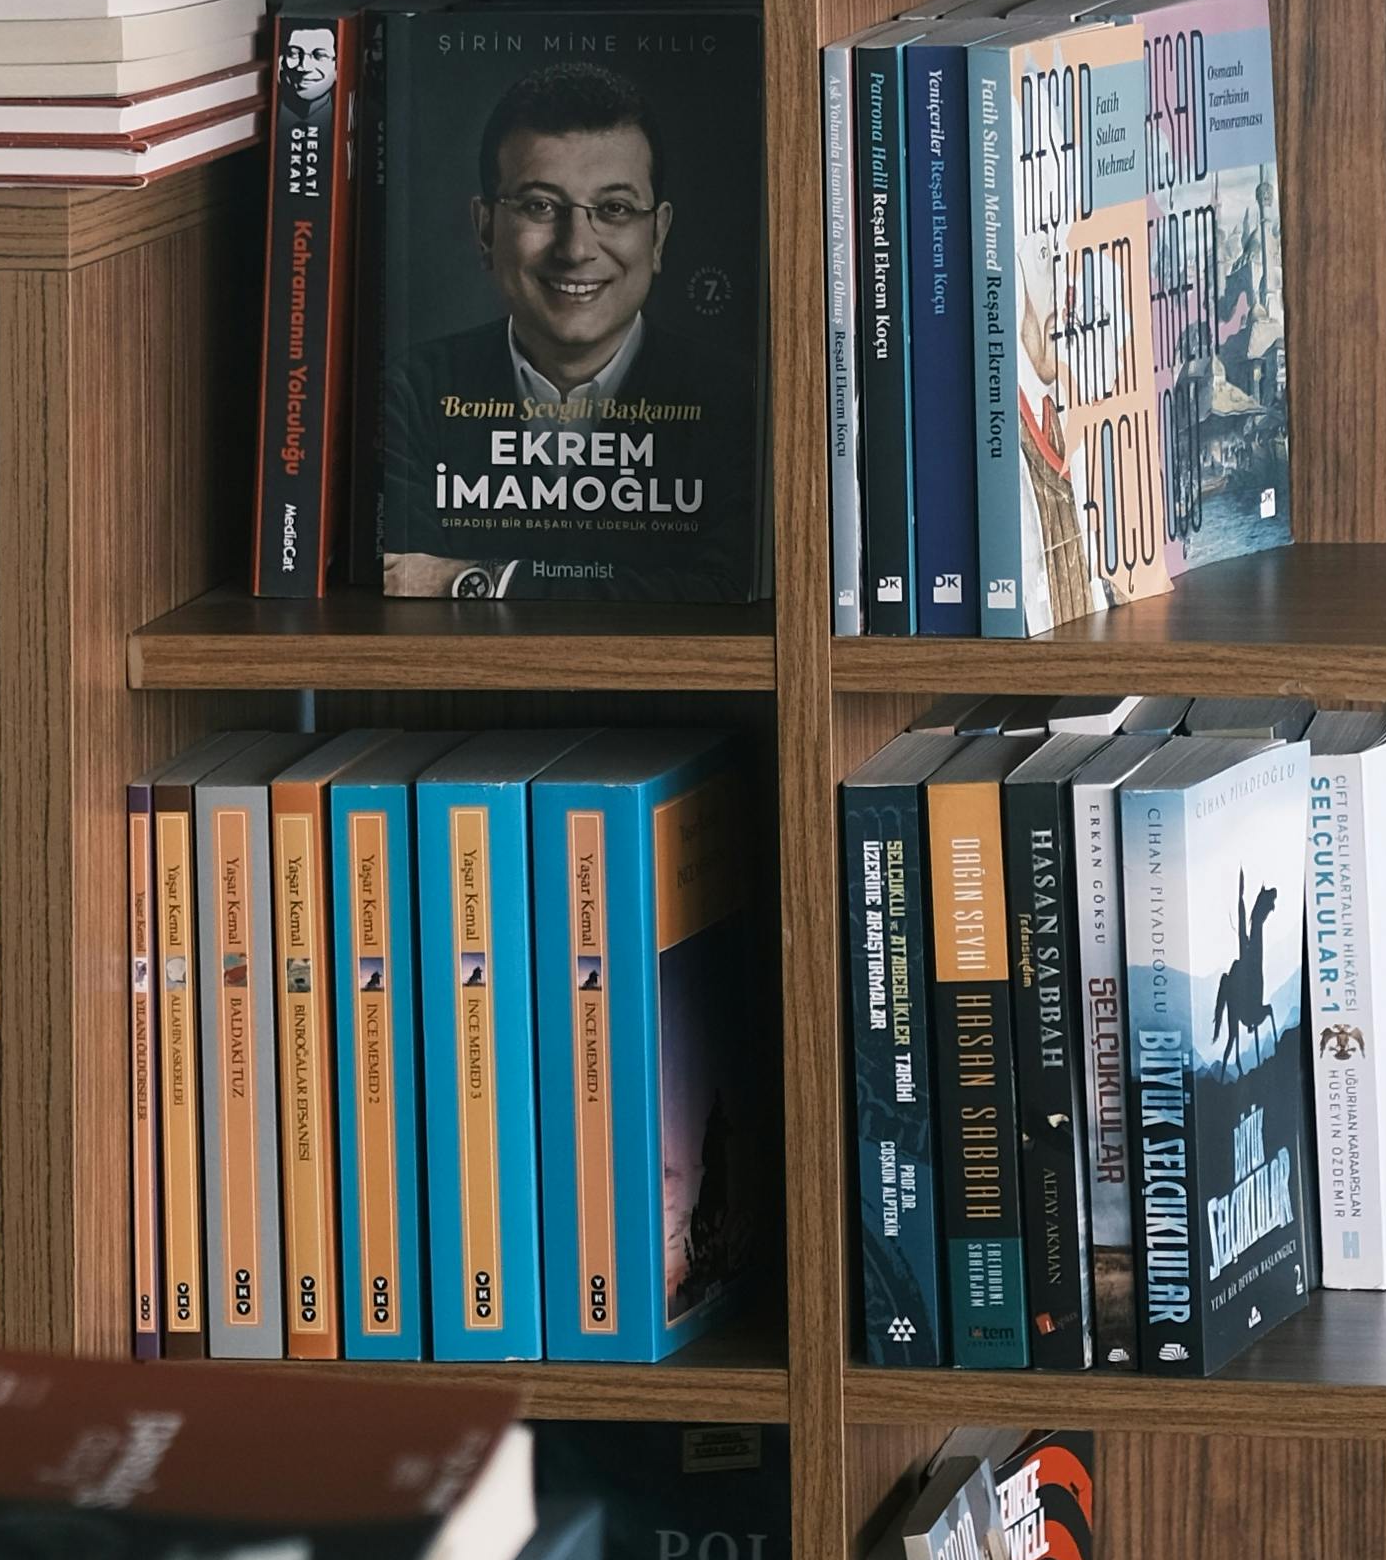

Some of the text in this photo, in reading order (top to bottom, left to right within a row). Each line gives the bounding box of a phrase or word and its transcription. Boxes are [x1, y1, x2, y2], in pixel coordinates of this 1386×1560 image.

[438, 31, 718, 56] ŞİRİN MİNE KILIÇ
[1207, 60, 1244, 81] Osmanlı
[1096, 91, 1120, 116] Fatih
[1096, 126, 1126, 146] Sultan
[1208, 87, 1250, 108] Tarihinin
[1209, 112, 1263, 132] Panoraması
[289, 126, 320, 197] NECATİ ÖZKAN
[926, 69, 949, 314] Yeniçeriler Reşad Ekrem Koçu
[1020, 62, 1093, 252] REŞAD
[1096, 149, 1136, 178] Mehmed
[870, 72, 891, 359] Patrona Halil Reşad Ekrem Koçu
[981, 78, 1006, 458] Fatih Sultan Mehmed Reşad Ekrem Koçu
[280, 221, 313, 476] Kahramanın Yolculuğu
[1051, 236, 1138, 413] EKREM
[440, 396, 703, 425] Benim Sevgili Başkanım
[491, 430, 654, 468] EKREM
[436, 462, 704, 513] İMAMOĞLU
[442, 516, 699, 532] SIRADIŞI BİR BAŞARI VE LİDERLİK ÖYKÜSÜ
[1083, 408, 1154, 594] KOÇU
[282, 503, 297, 572] MediaCat
[533, 560, 614, 579] Humanist
[1195, 763, 1296, 819] CİHAN PİYADEOĞLU
[165, 865, 182, 946] Yaşar Kemal
[223, 857, 242, 945] Yaşar Kemal
[285, 856, 305, 947] Yaşar Kemal
[358, 854, 378, 946] Yaşar Kemal
[460, 849, 480, 941] Yaşar Kemal
[576, 853, 596, 947] Yaşar Kemal
[951, 838, 991, 970] DAĞIN ŞEYHİ
[1089, 804, 1106, 945] ERKAN GÖKSU
[1147, 808, 1169, 1014] CİHAN PİYADEOĞLU
[1308, 776, 1341, 1013] SELÇUKLULAR-1
[1332, 775, 1357, 1012] ÇİFT BAŞLI KARTALIN HİKÂYESİ
[863, 841, 886, 1030] ÜZERİNE ARAŞTIRMALAR
[1031, 830, 1064, 1068] HASAN SABBAH
[230, 997, 245, 1098] BALDAKİ TUZ
[467, 998, 479, 1032] İNCE
[294, 1004, 310, 1161] BİNBOĞALAR EFSANESİ
[469, 1035, 482, 1090] MEMED
[956, 994, 1002, 1219] HASAN SABBAH
[1088, 977, 1125, 1184] SELÇUKLULAR
[879, 1141, 901, 1237] COŞKUN ALPTEKİN
[1139, 1029, 1192, 1325] BÜYÜK SELÇUKLULAR
[1233, 1104, 1265, 1185] BÜYÜK
[1328, 1069, 1346, 1218] HÜSEYİN ÖZDEMİR
[1344, 1068, 1361, 1218] UĞURHAN KARAARSLAN
[1042, 1168, 1062, 1284] ALTAY AKMAN
[1207, 1146, 1294, 1281] SELÇUKLULAR
[996, 1459, 1041, 1529] EORGE
